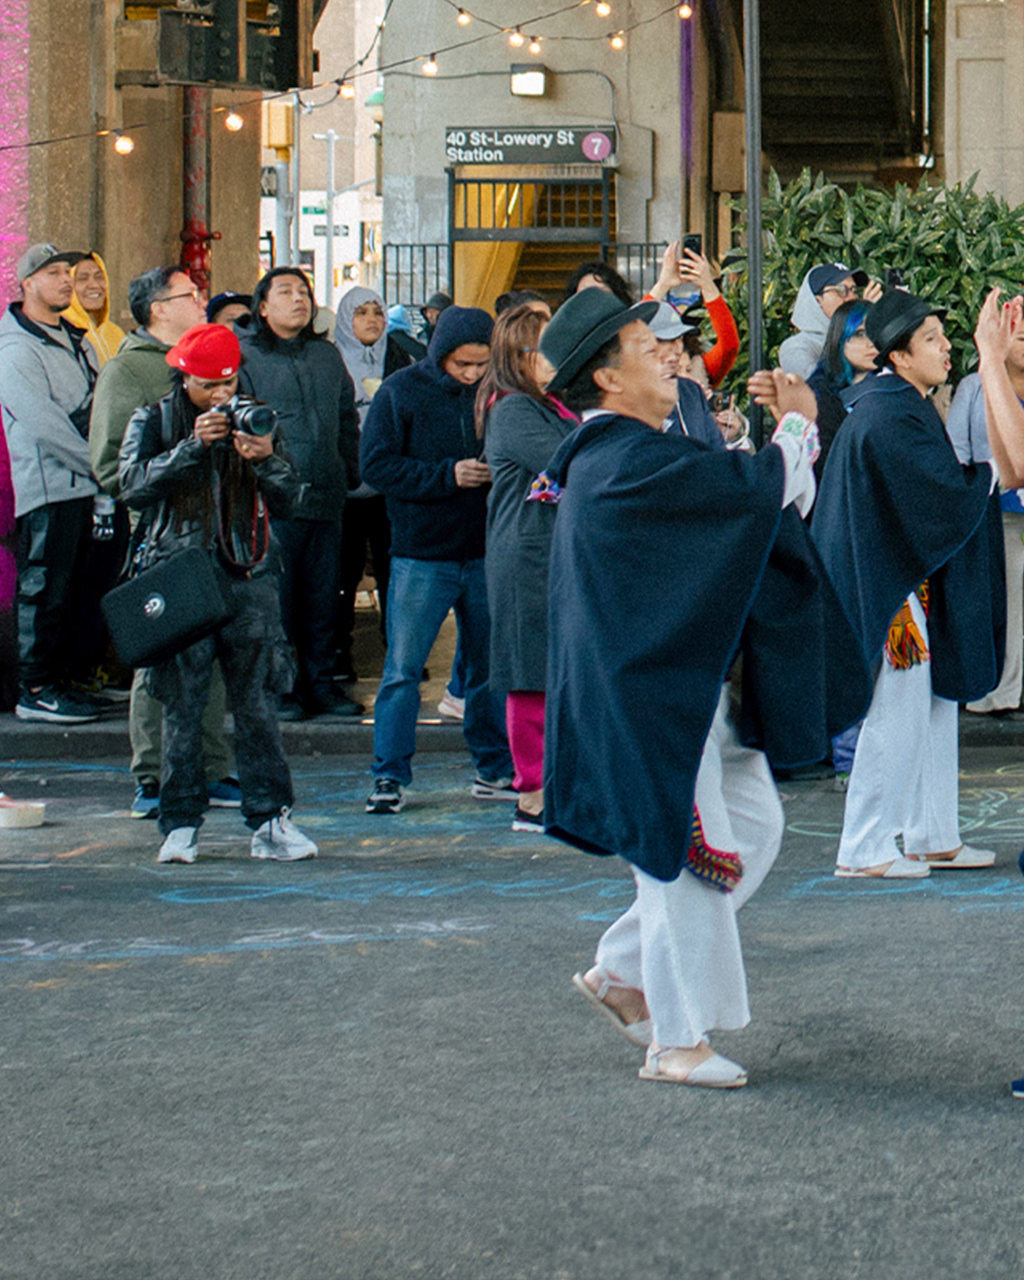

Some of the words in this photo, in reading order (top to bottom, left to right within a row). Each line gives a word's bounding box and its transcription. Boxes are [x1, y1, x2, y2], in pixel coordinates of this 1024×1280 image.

[446, 131, 466, 146] 40
[469, 131, 553, 148] St-Lowery
[557, 130, 575, 145] St
[591, 137, 602, 155] 7
[446, 148, 504, 162] Station
